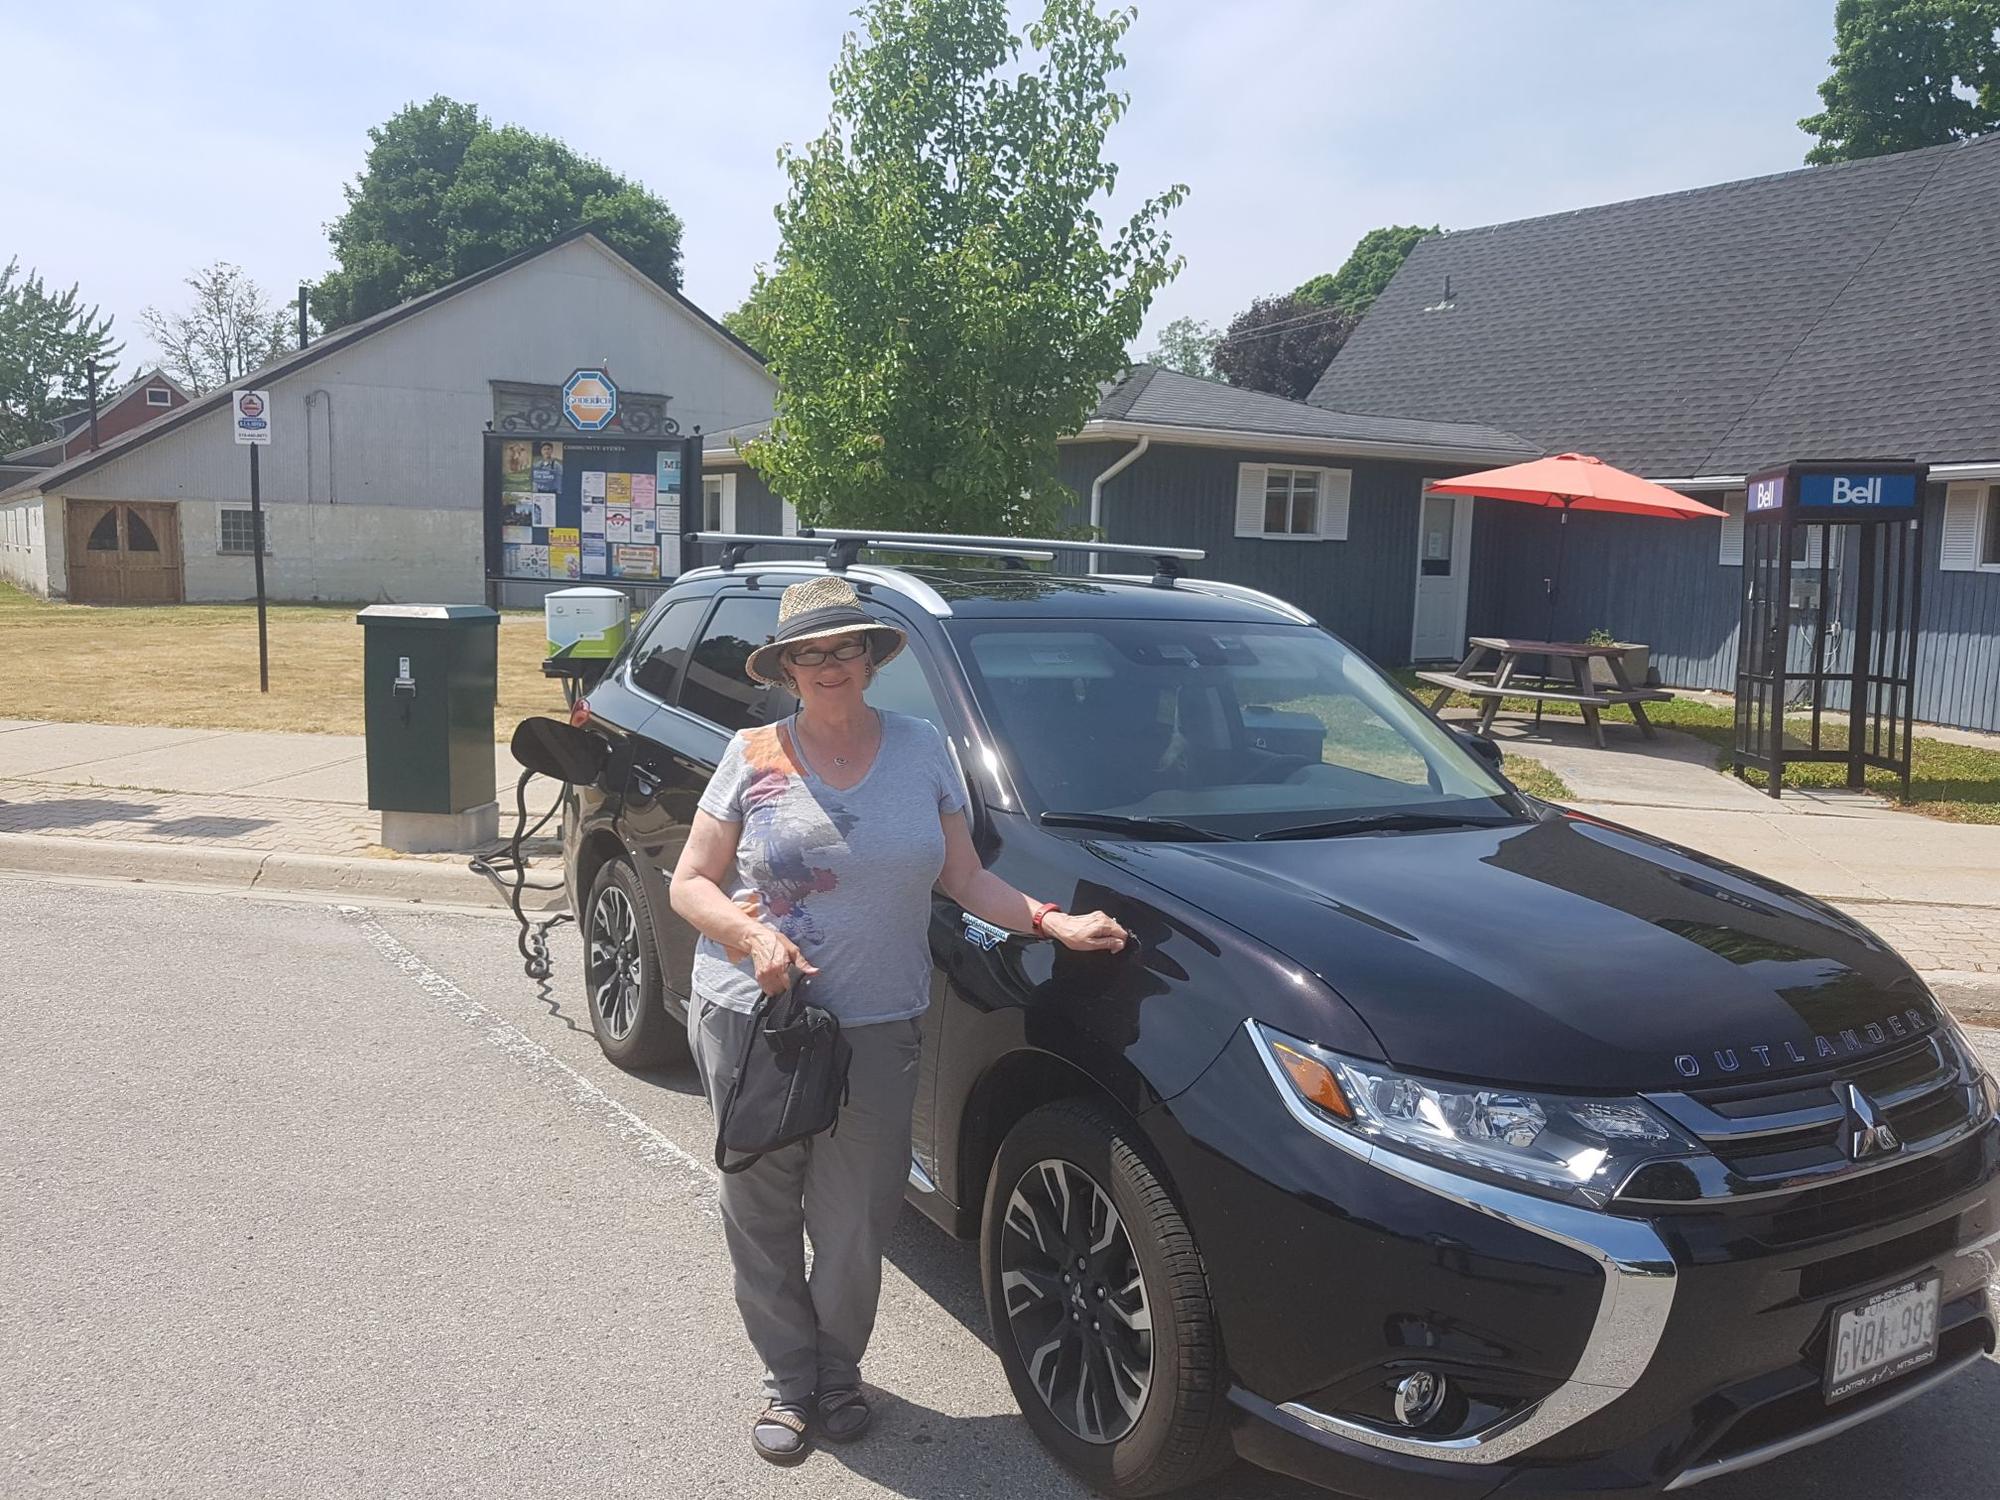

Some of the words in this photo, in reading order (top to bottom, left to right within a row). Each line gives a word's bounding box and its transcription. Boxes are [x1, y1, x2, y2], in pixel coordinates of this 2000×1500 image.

[1757, 481, 1775, 508] Bell
[1832, 477, 1882, 504] Bell
[1674, 1008, 1926, 1077] OUTLANDER
[1837, 1315, 1886, 1375] GVBA
[1900, 1297, 1936, 1349] 993
